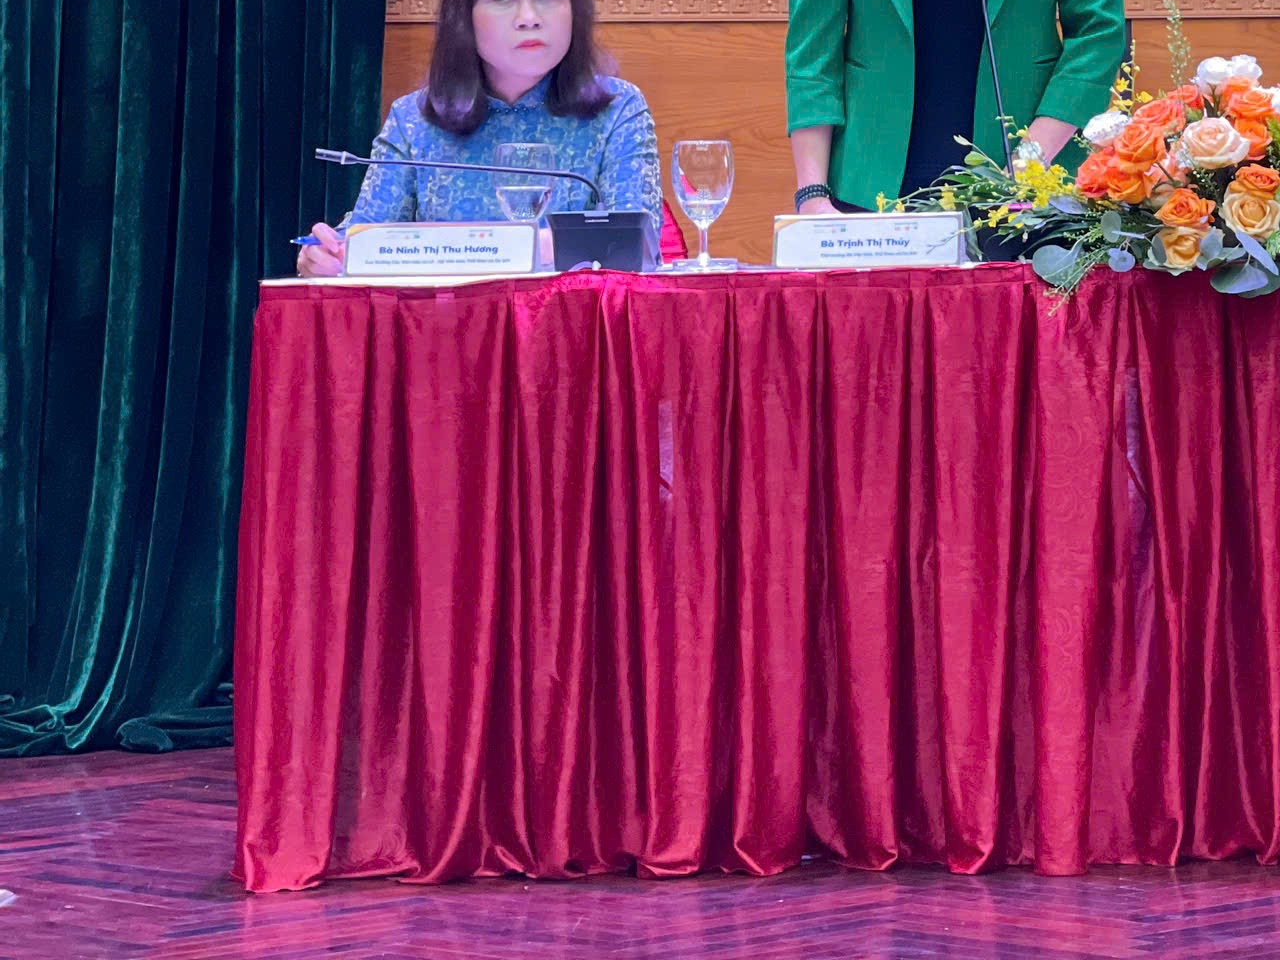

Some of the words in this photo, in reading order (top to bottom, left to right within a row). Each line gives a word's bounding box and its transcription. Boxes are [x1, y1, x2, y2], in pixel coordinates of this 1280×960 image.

[820, 238, 835, 248] Bà
[838, 238, 864, 249] Trịnh
[867, 238, 882, 249] Thị
[379, 245, 393, 255] Bà
[396, 245, 420, 254] Ninh
[423, 245, 439, 256] Thị
[442, 245, 461, 254] Thu
[464, 245, 499, 255] Hương
